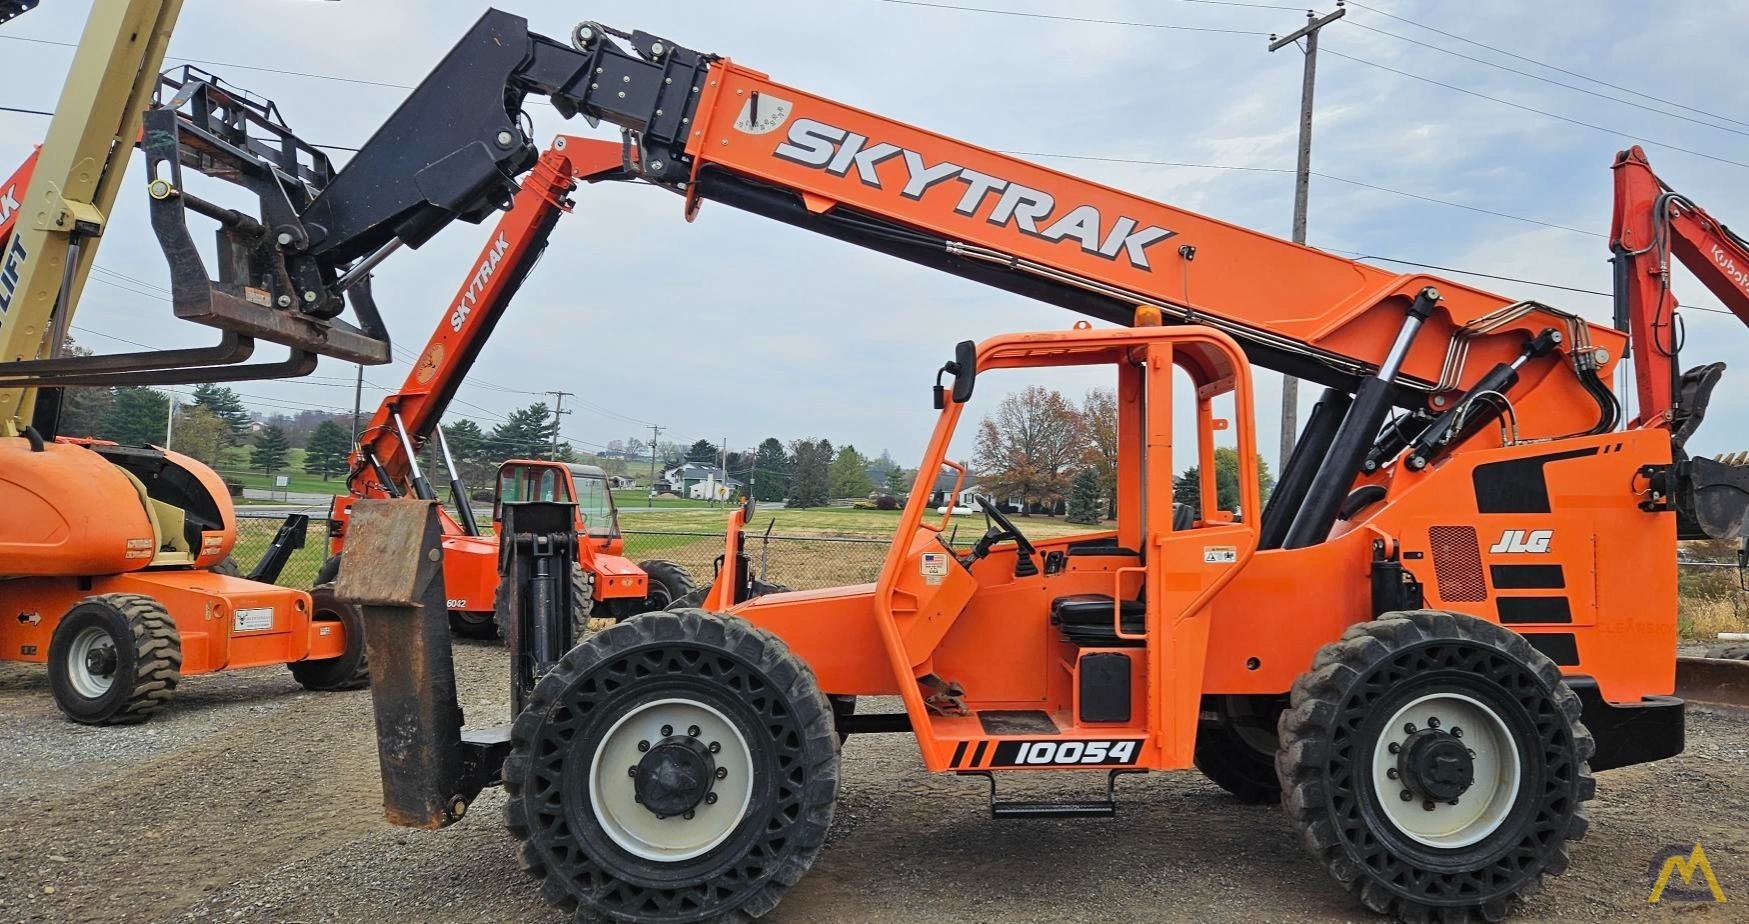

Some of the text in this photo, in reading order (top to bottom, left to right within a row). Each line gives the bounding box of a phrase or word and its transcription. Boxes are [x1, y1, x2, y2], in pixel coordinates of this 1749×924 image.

[772, 118, 1179, 272] SKYTRAK
[0, 233, 27, 313] LIFT
[450, 230, 510, 333] SKYTRAK
[1489, 529, 1554, 553] JLG
[446, 599, 467, 608] 6042
[1014, 741, 1136, 764] 10054
